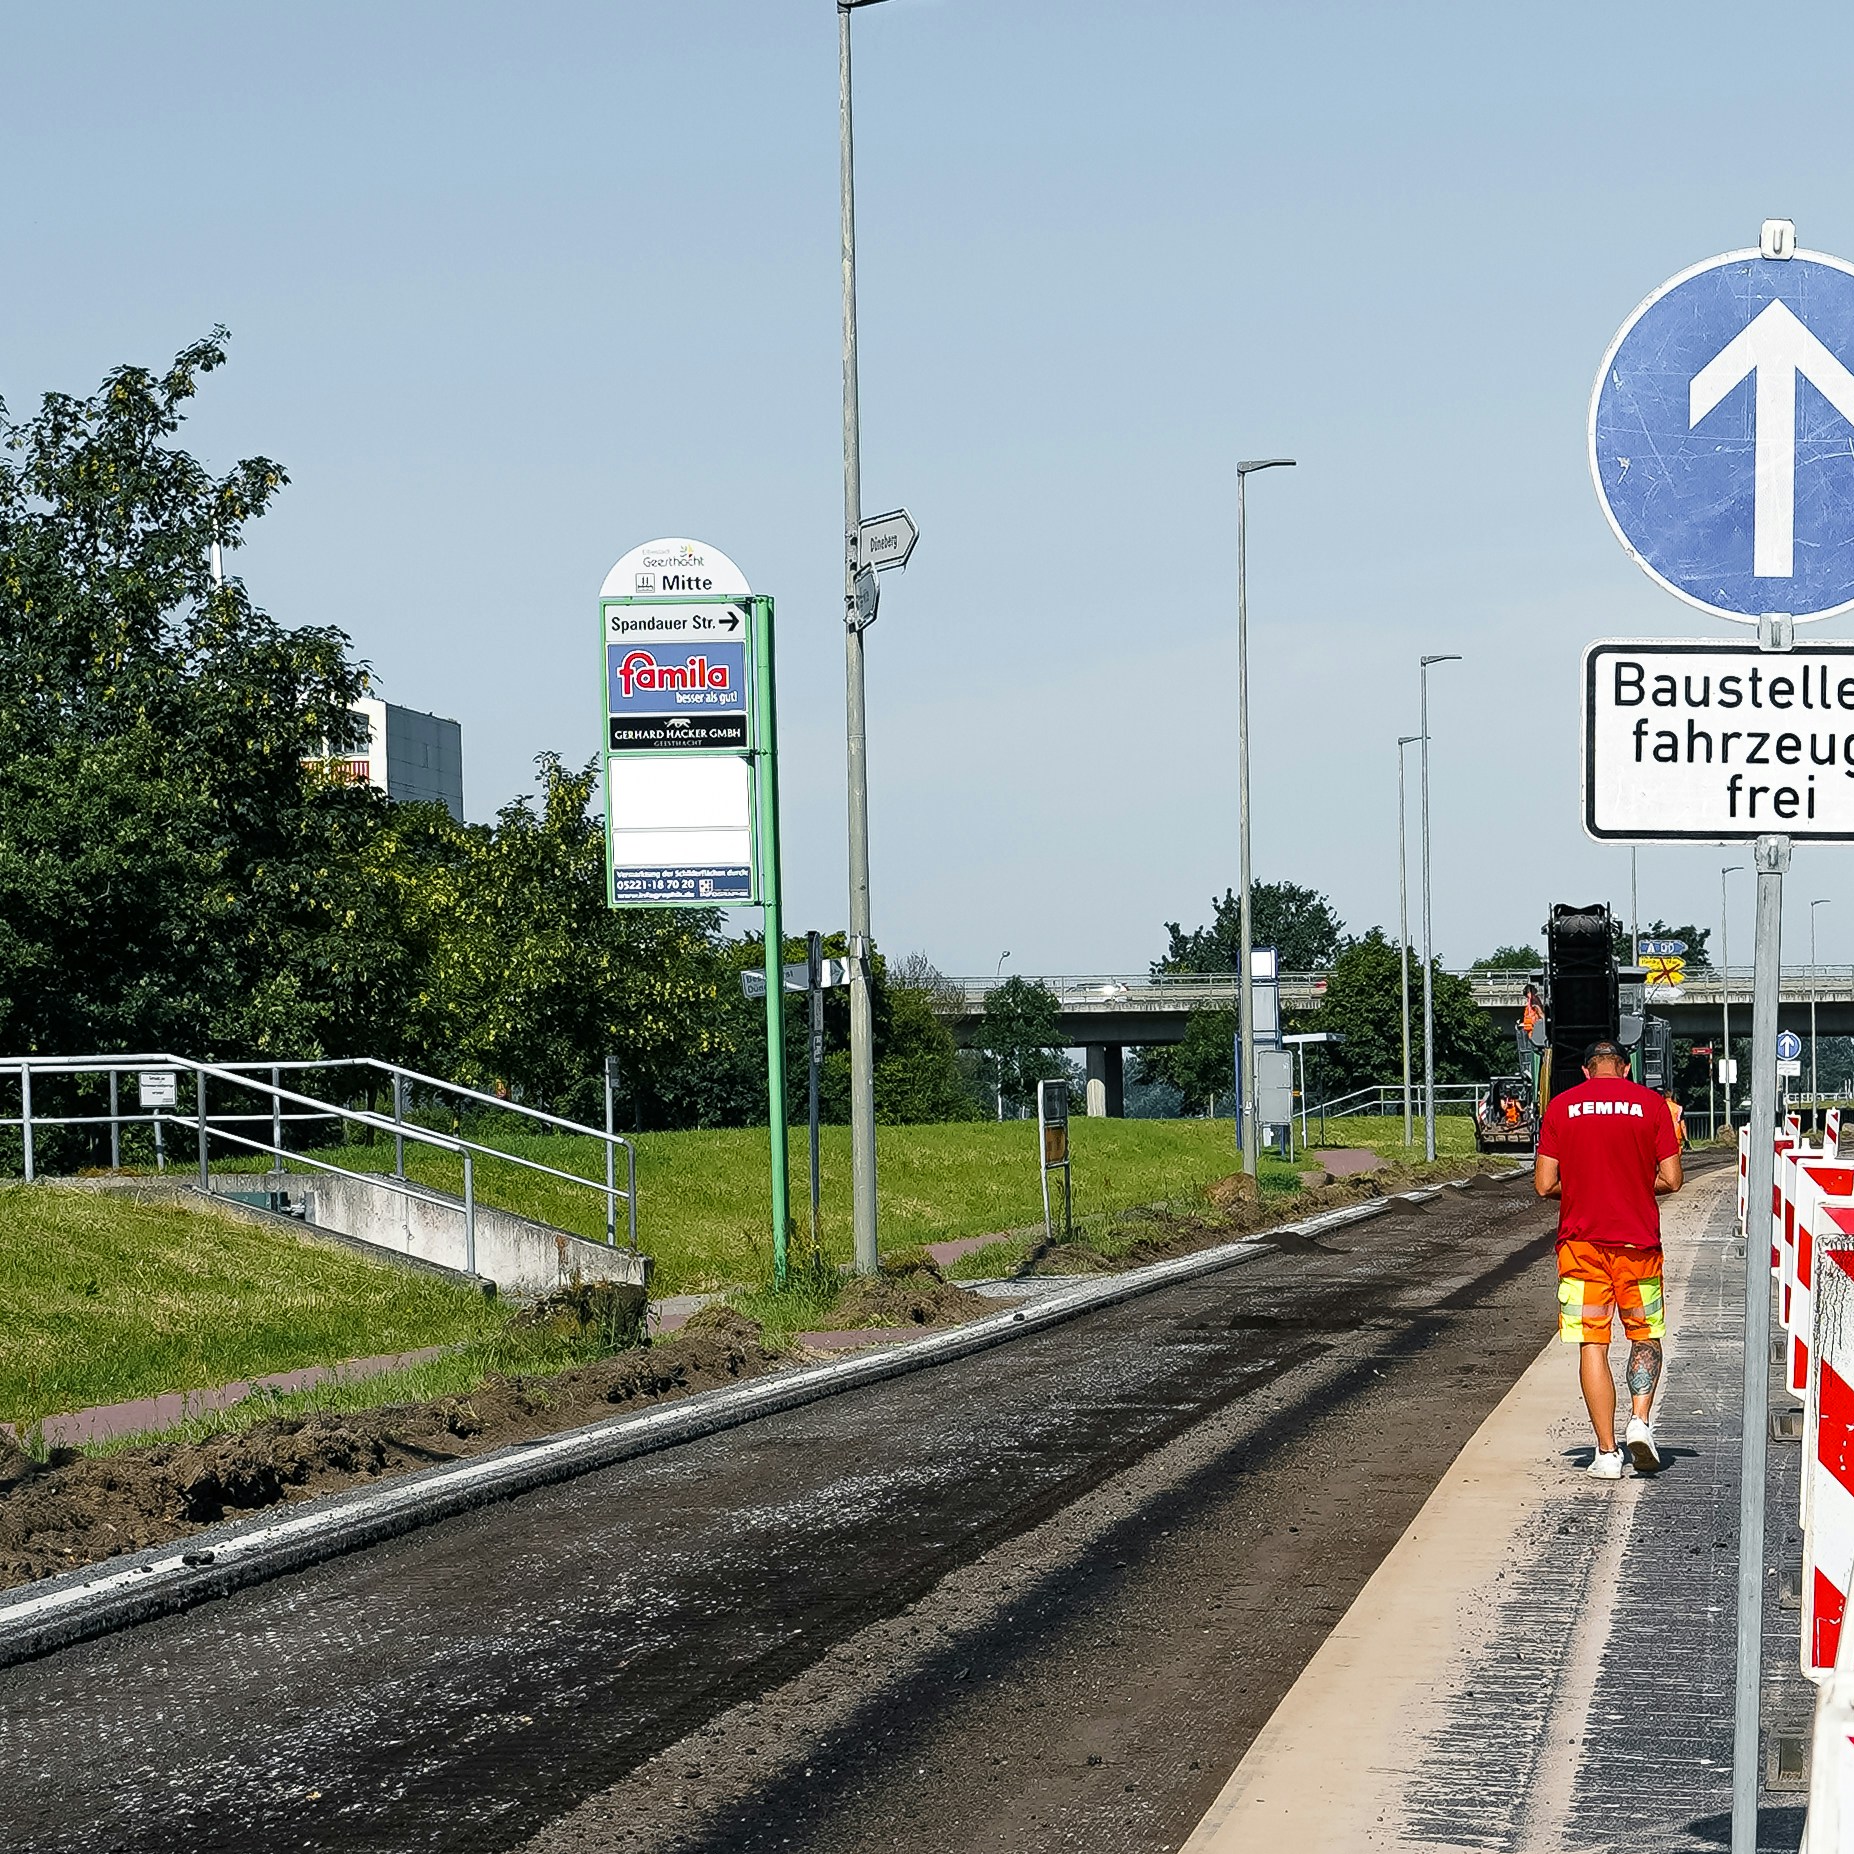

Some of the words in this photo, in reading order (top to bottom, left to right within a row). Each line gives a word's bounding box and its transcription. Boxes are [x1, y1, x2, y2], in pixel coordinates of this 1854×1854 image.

[642, 555, 705, 568] Geesthacht
[662, 574, 713, 591] Mitte
[611, 615, 688, 635] Spandauer
[692, 614, 716, 630] Str.
[618, 651, 729, 696] famila
[675, 691, 704, 704] besser
[704, 691, 718, 703] als
[614, 729, 665, 740] GERHARD
[666, 729, 708, 739] HACKER
[708, 728, 741, 738] GMBH
[1726, 773, 1815, 819] frei
[666, 879, 680, 889] 70
[681, 879, 695, 889] 20
[1568, 1101, 1644, 1119] KEMNA
